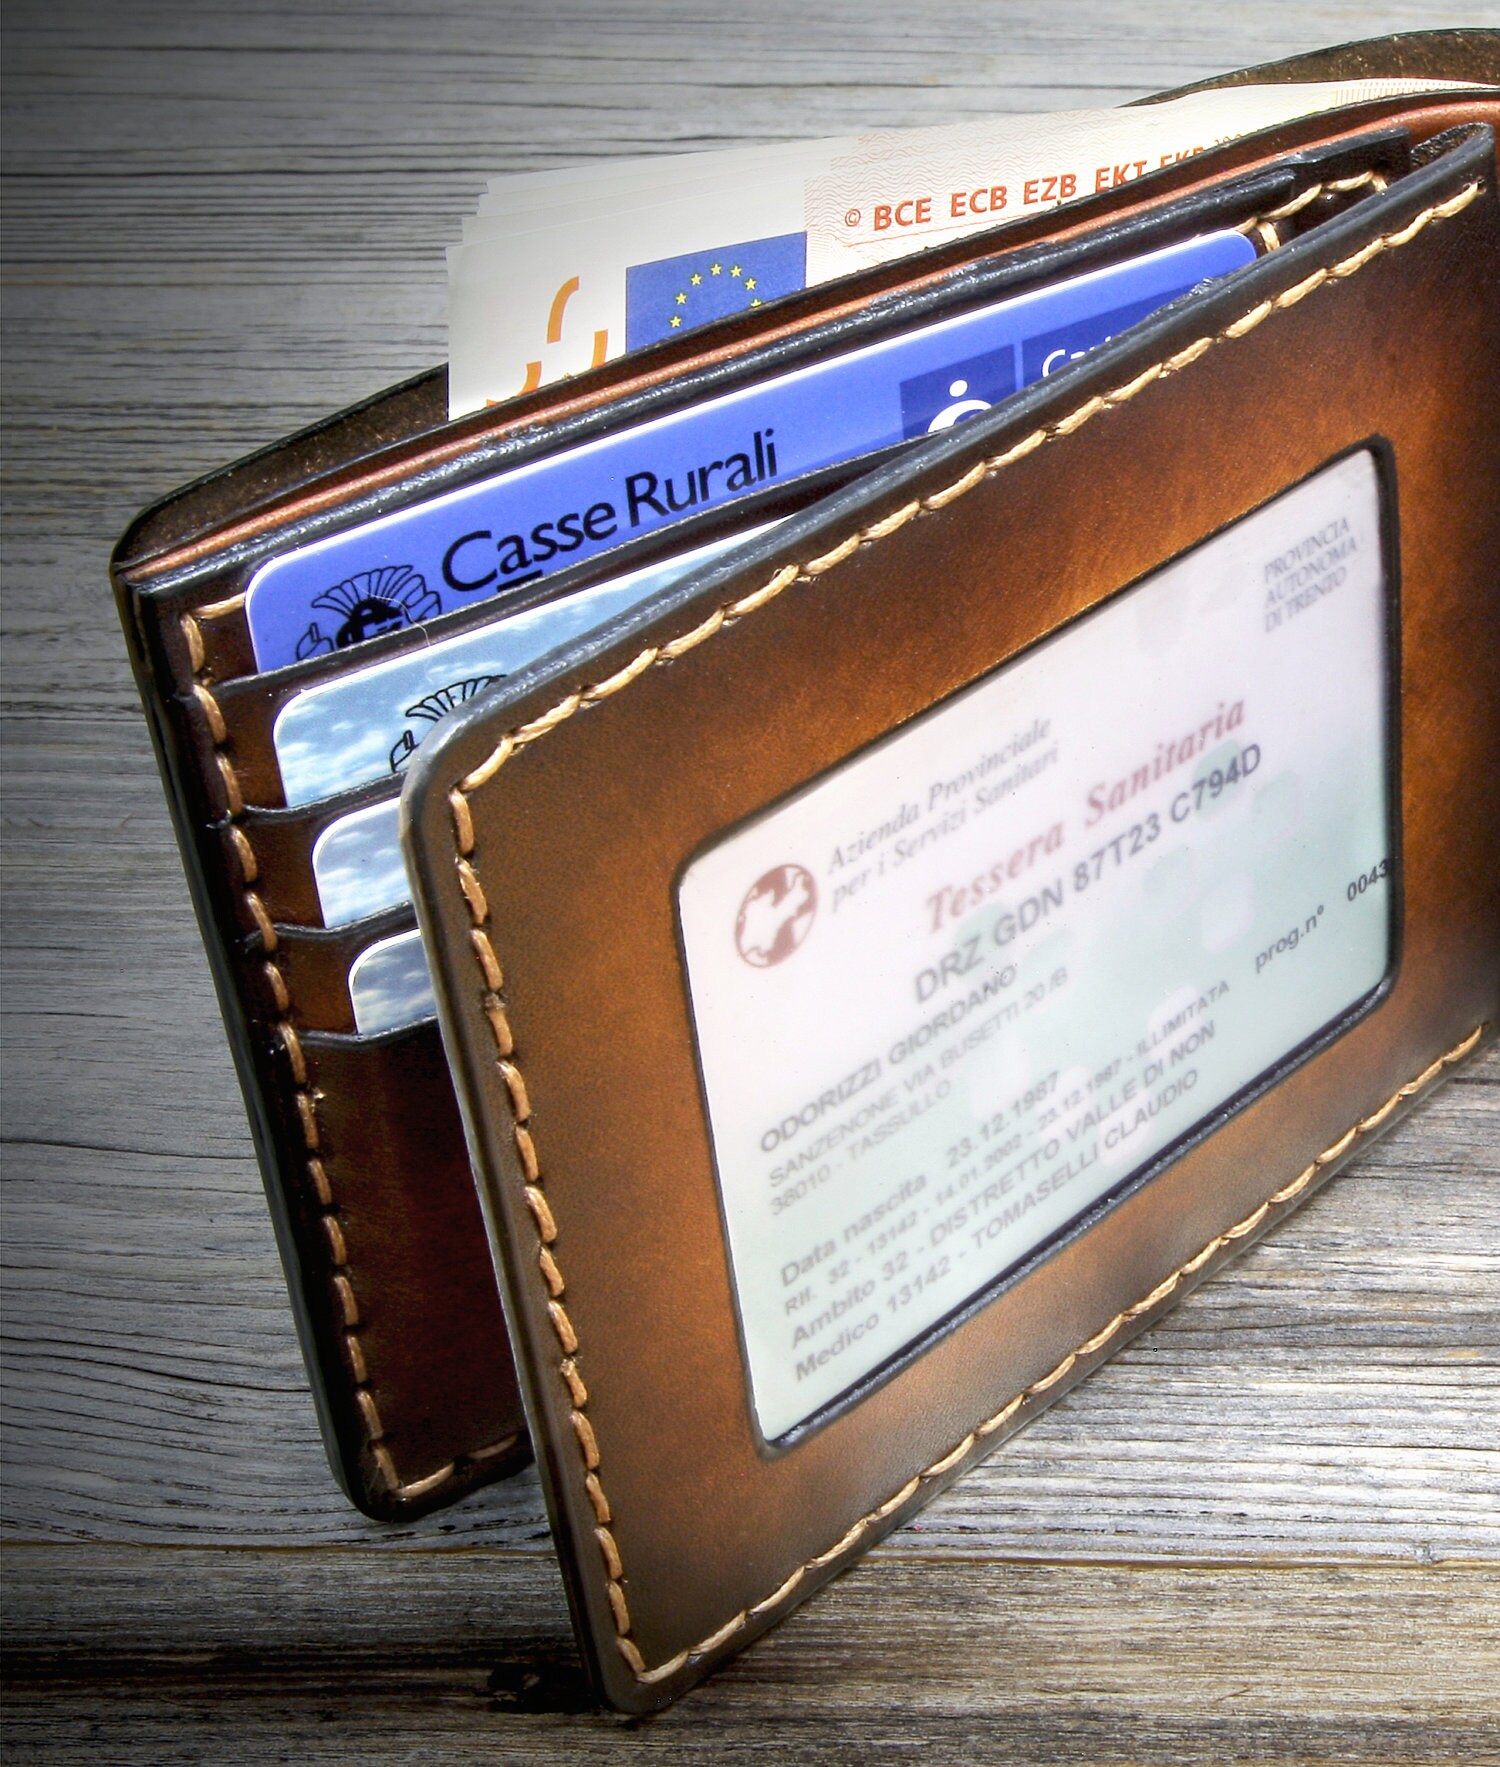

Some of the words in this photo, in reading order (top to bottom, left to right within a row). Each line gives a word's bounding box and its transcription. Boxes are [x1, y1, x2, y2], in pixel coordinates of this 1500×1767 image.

[874, 198, 931, 231] BCE
[951, 185, 1007, 217] ECB
[1023, 173, 1076, 206] EZB
[1095, 159, 1147, 193] EKT
[442, 502, 618, 592] Casse
[625, 428, 777, 528] Rurali
[1264, 517, 1349, 584] PROVINCIA
[1265, 536, 1357, 607] AUTONOMA
[1265, 606, 1282, 633] DI
[1286, 566, 1347, 619] TRENTO
[828, 803, 919, 875] Azienda
[928, 718, 1051, 812] Provinciale
[832, 867, 871, 914] per
[893, 807, 966, 867] Servizi
[974, 740, 1059, 814] Sanitari
[913, 935, 985, 1004] DRZ
[991, 879, 1063, 948] GDN
[1073, 812, 1161, 892] 87T23
[1170, 743, 1262, 823] C794D
[925, 821, 1065, 934] Tessera
[1083, 699, 1245, 828] Sanitaria
[760, 1058, 882, 1152] ODORIZZI
[888, 964, 1017, 1065] GIORDANO
[769, 1086, 899, 1187] SANZENONE
[902, 1063, 936, 1093] VIA
[939, 1001, 1020, 1070] BUSETTI
[1136, 980, 1231, 1058] ILLIMITATA
[792, 1279, 876, 1349] Ambito
[881, 1250, 908, 1282] 32
[929, 1138, 1060, 1248] DISTRETTO
[1065, 1079, 1137, 1142] VALLE
[1142, 1060, 1164, 1088] DI
[1170, 1020, 1216, 1067] NON
[848, 1079, 952, 1161] TASSULLO
[781, 1238, 838, 1288] Data
[842, 1173, 927, 1244] nascita
[794, 1312, 880, 1382] Medico
[886, 1255, 951, 1313] 13142
[971, 1142, 1098, 1248] TOMASELLI
[1104, 1068, 1198, 1149] CLAUDIO
